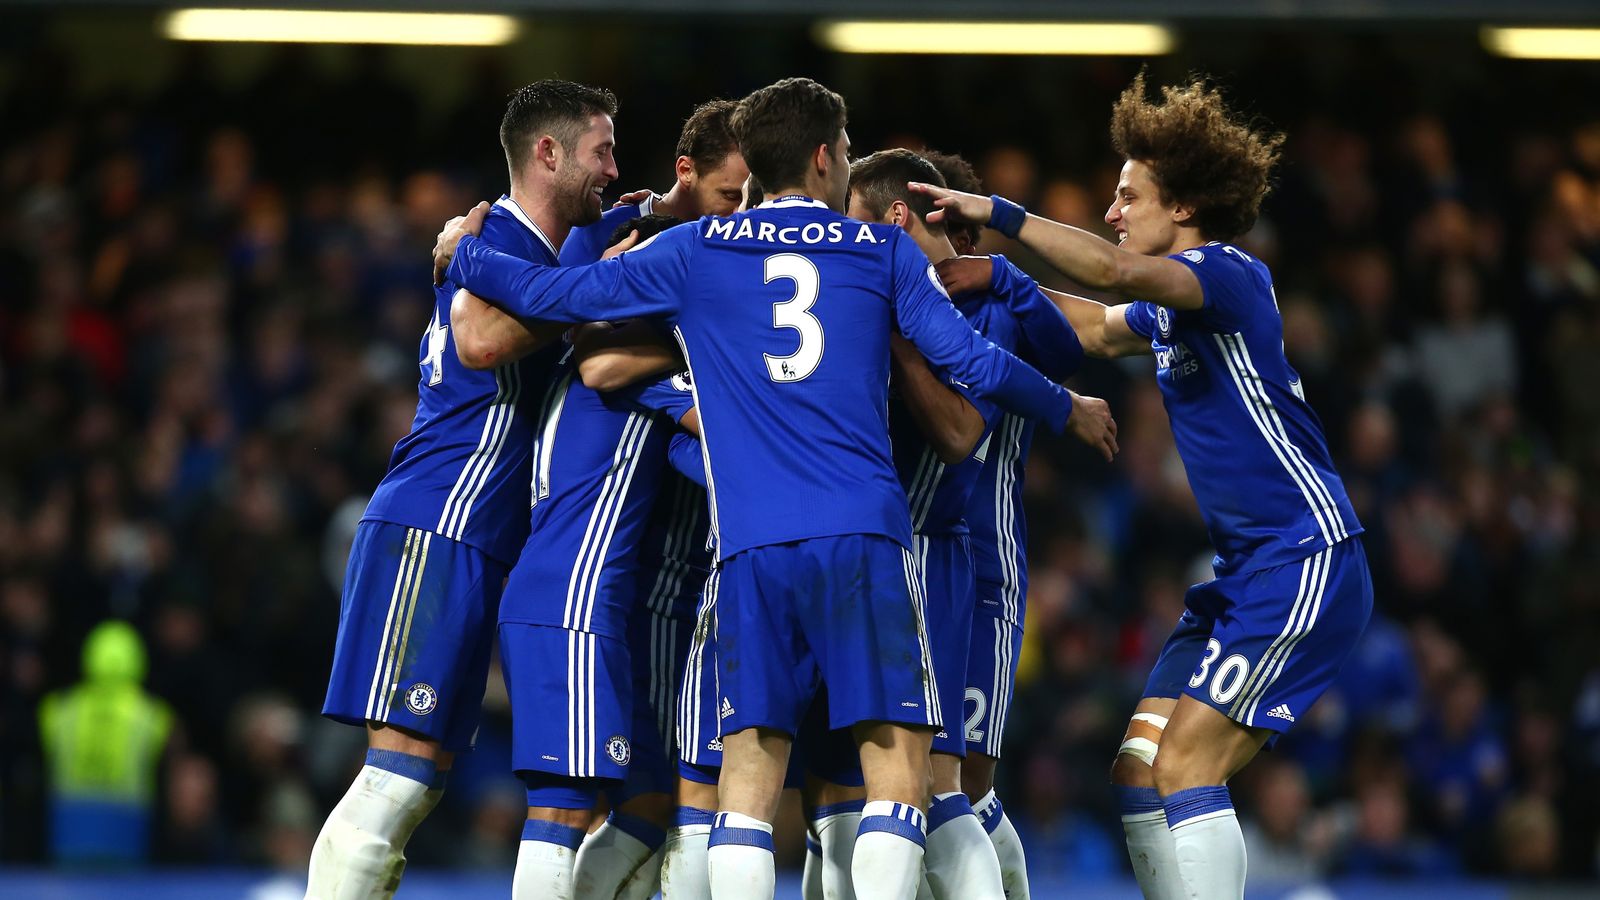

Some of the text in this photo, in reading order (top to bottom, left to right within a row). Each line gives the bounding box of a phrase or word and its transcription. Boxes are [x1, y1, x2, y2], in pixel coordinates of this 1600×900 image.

[704, 218, 887, 244] MARCOS A.
[762, 252, 825, 383] 3
[1188, 637, 1250, 705] 30
[1266, 709, 1295, 723] adidas
